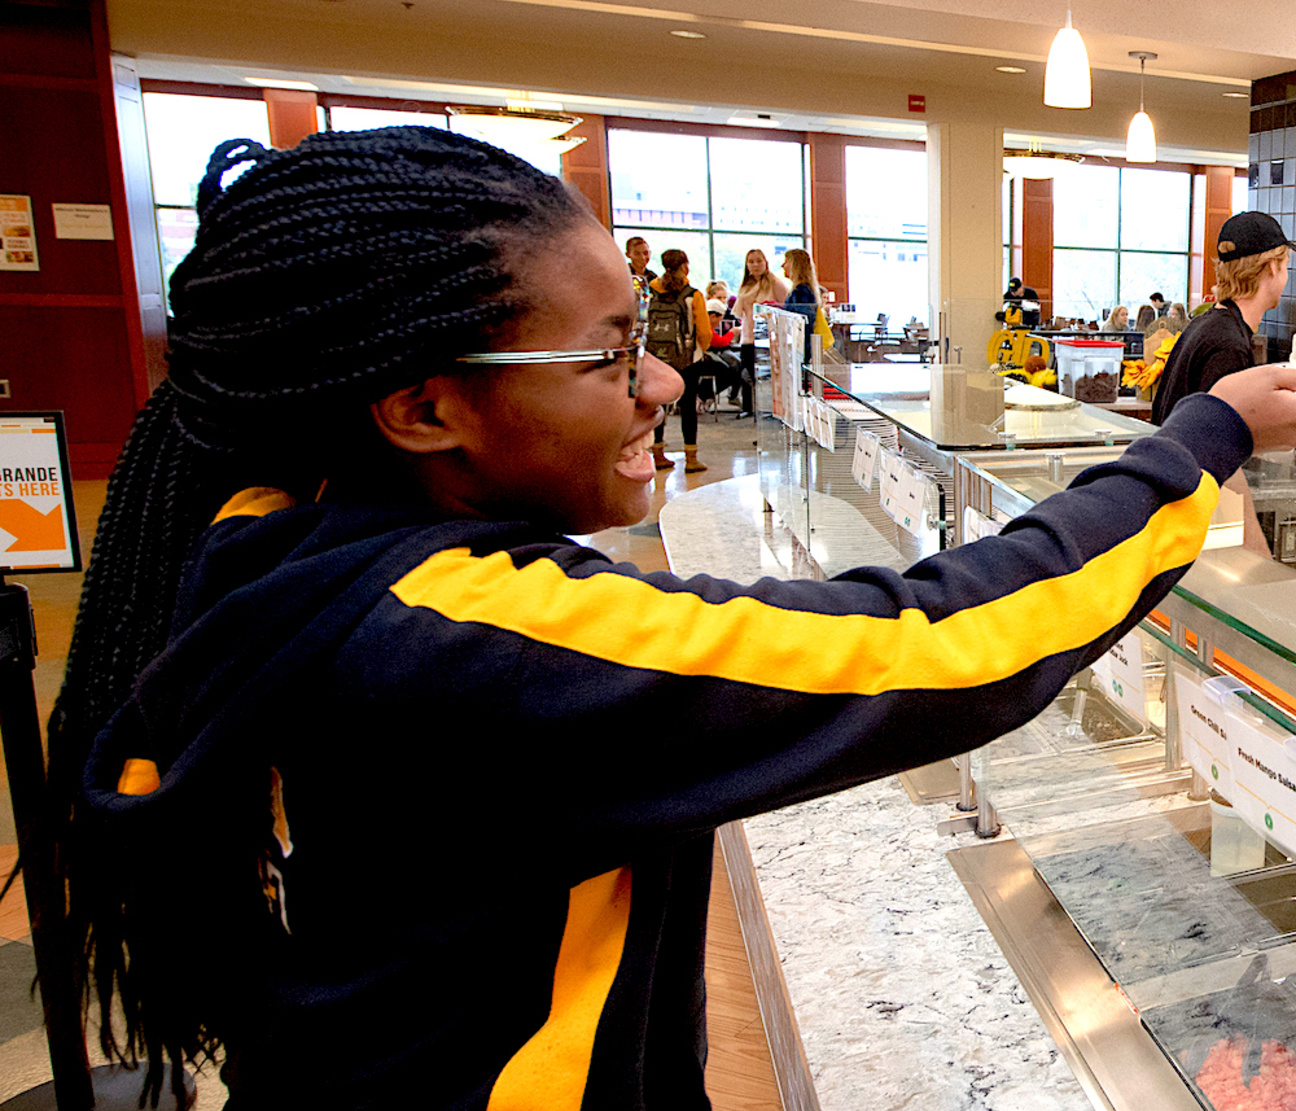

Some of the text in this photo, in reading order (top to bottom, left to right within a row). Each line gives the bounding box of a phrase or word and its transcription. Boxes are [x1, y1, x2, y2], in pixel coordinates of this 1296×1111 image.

[0, 467, 58, 482] RANDE
[19, 482, 60, 497] HERE
[1190, 704, 1207, 724] Green
[1238, 746, 1296, 793] Fresh Mango Salsa
